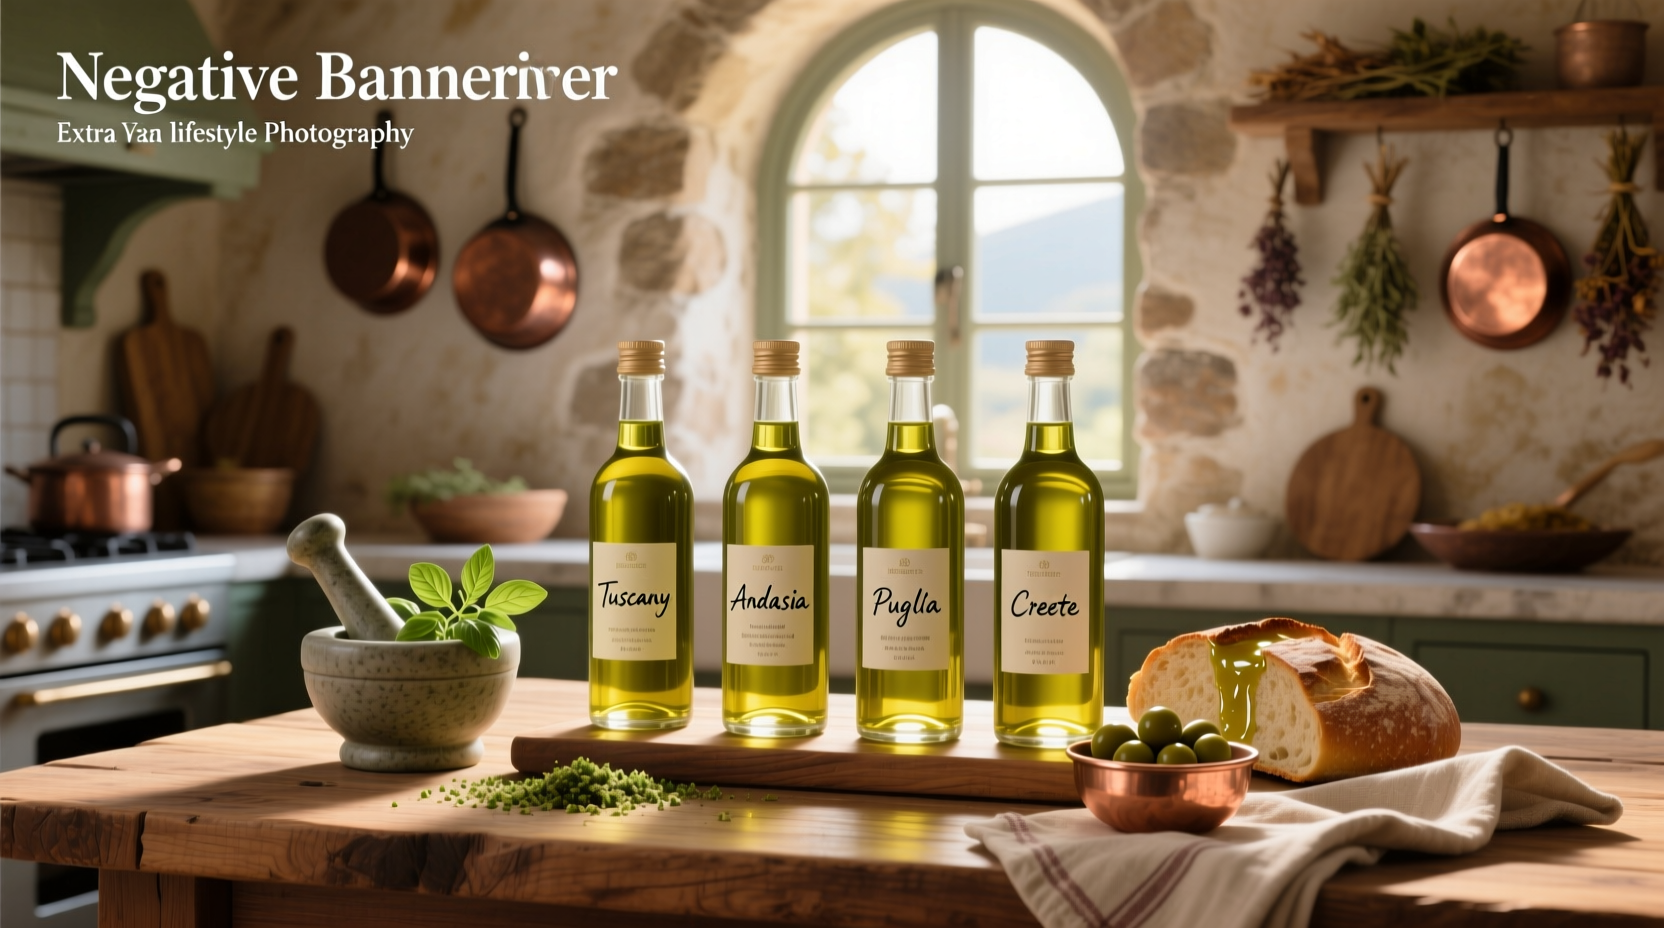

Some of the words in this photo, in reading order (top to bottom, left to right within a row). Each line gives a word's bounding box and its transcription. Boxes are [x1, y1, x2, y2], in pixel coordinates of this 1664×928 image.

[598, 580, 671, 618] Tuscany
[730, 583, 810, 611] Andasia
[1011, 589, 1080, 618] Creete
